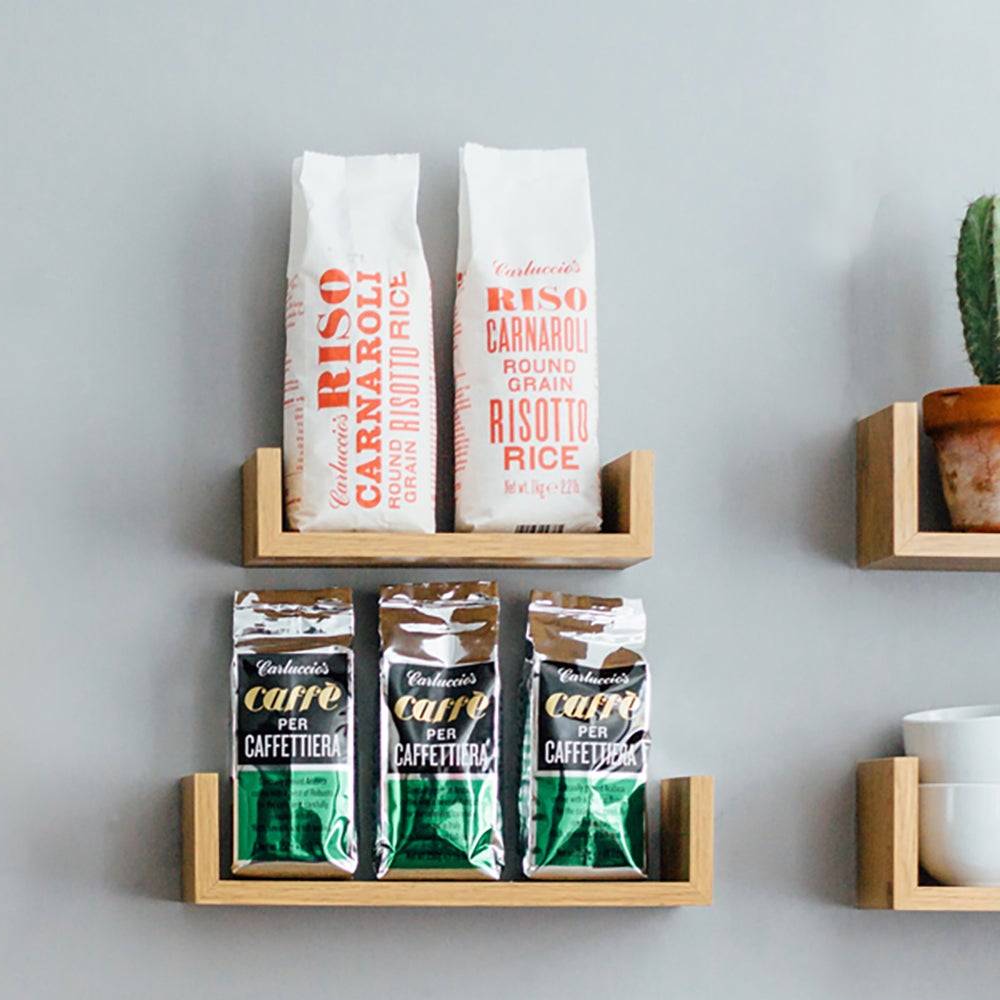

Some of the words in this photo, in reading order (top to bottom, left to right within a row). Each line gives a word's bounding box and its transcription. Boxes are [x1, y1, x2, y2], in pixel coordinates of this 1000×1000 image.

[492, 258, 582, 278] Carluccio's
[389, 271, 410, 340] RICE
[486, 286, 588, 312] RISO
[317, 268, 351, 411] RISO
[486, 316, 589, 354] CARNAROLI
[503, 359, 576, 375] ROUND
[356, 271, 383, 509] CARNAROLI
[389, 347, 420, 432] RISOTTO
[507, 377, 574, 392] GRAIN
[489, 398, 589, 444] RISOTTO
[329, 413, 349, 510] Carluccio's
[503, 446, 581, 471] RICE
[388, 439, 402, 510] ROUND
[404, 440, 417, 504] GRAIN
[256, 659, 330, 676] Carluccio's
[406, 669, 478, 688] Carluccio's
[556, 666, 631, 686] Carluccio's
[244, 681, 342, 713] caffè
[394, 690, 490, 723] caffè
[278, 717, 308, 731] PER
[426, 727, 457, 742] PER
[578, 725, 609, 739] PER
[244, 734, 341, 759] CAFFETTIERA
[394, 743, 488, 768] CAFFETTIERA
[545, 741, 638, 767] CAFFETTIERA
